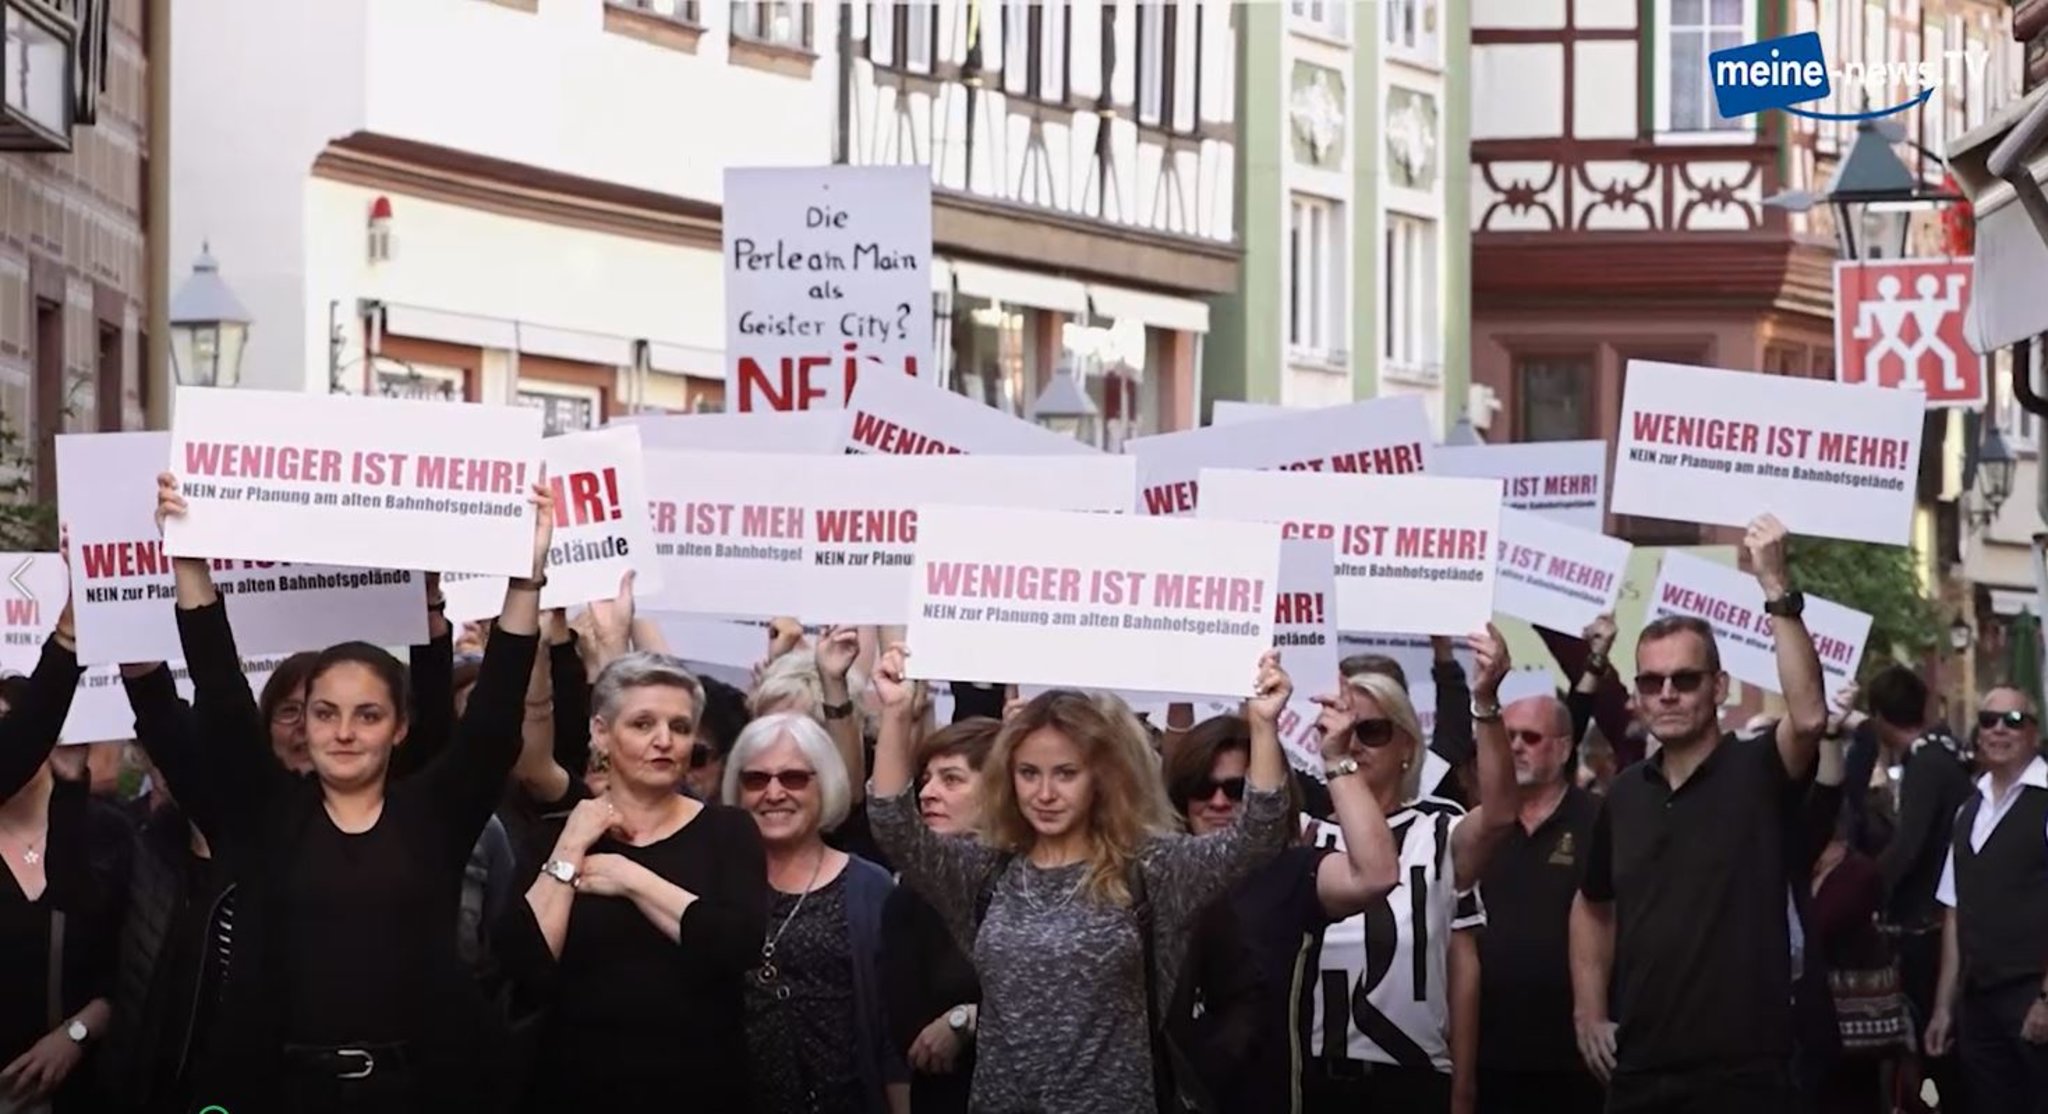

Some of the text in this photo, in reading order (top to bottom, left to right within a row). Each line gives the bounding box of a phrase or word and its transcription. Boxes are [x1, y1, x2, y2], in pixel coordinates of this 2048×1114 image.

[806, 205, 849, 228] Die
[734, 238, 802, 271] Perle
[853, 242, 917, 271] Main
[808, 281, 844, 299] als
[739, 303, 911, 343] Geister City?
[1633, 411, 1910, 470] WENIGER IST MEHR!
[185, 441, 527, 495] WENIGER IST MEHR!
[1629, 448, 1904, 492] NEIN zur Planung am alten Bahnhofsgelände
[182, 481, 523, 518] NEIN zur Planung am alten Bahnhofsgelände
[1512, 474, 1598, 497] IST MEHR!
[685, 502, 735, 536] IST
[815, 509, 918, 543] WENIG
[545, 536, 629, 568] elände
[677, 542, 712, 557] alten
[815, 550, 914, 566] NEIN zur Planu
[1342, 524, 1389, 556] IST
[1395, 526, 1488, 561] MEHR!
[87, 587, 118, 603] NEIN
[121, 586, 143, 601] zur
[237, 576, 275, 594] alten
[279, 568, 411, 592] Bahnhofsgelände
[1333, 562, 1484, 582] alten Bahnhofsgelände
[1510, 545, 1546, 572] IST
[1548, 555, 1614, 593] MEHR!
[926, 561, 1264, 614] WENIGER IST MEHR!
[923, 604, 1260, 637] NEIN zur Planung am alten Bahnhofsgelände
[1662, 582, 1752, 630] WENIGER
[1754, 614, 1774, 638] IS
